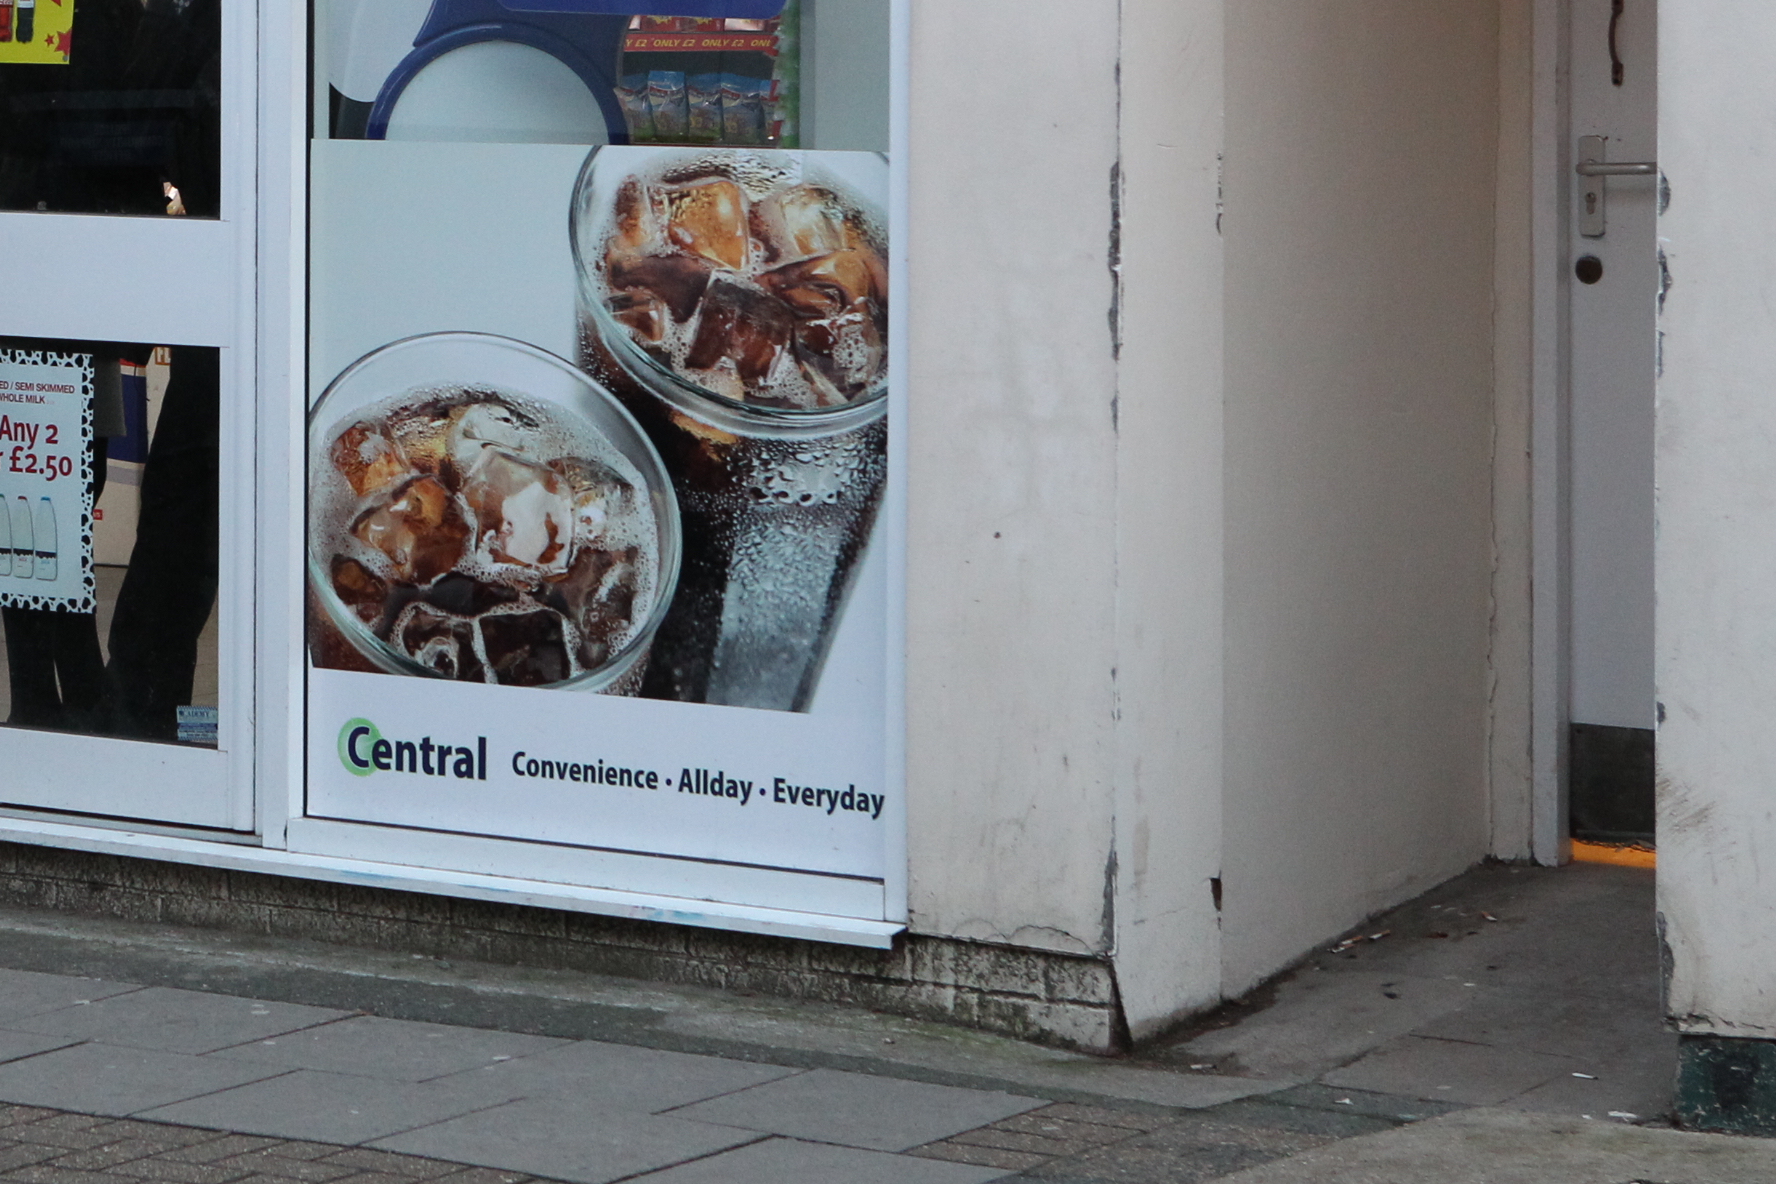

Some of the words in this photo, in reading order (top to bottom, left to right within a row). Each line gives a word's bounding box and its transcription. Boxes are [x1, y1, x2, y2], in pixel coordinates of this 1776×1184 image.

[653, 39, 681, 47] ONLY
[702, 39, 728, 47] ONLY
[15, 382, 34, 391] SEMI
[36, 383, 75, 394] SKIMMED
[26, 395, 45, 404] MILK
[45, 424, 58, 444] 2
[9, 446, 73, 481] £2.50
[347, 725, 487, 781] Central
[512, 751, 658, 791] Convenience
[679, 768, 753, 806] Allday
[773, 777, 885, 820] Everyday
